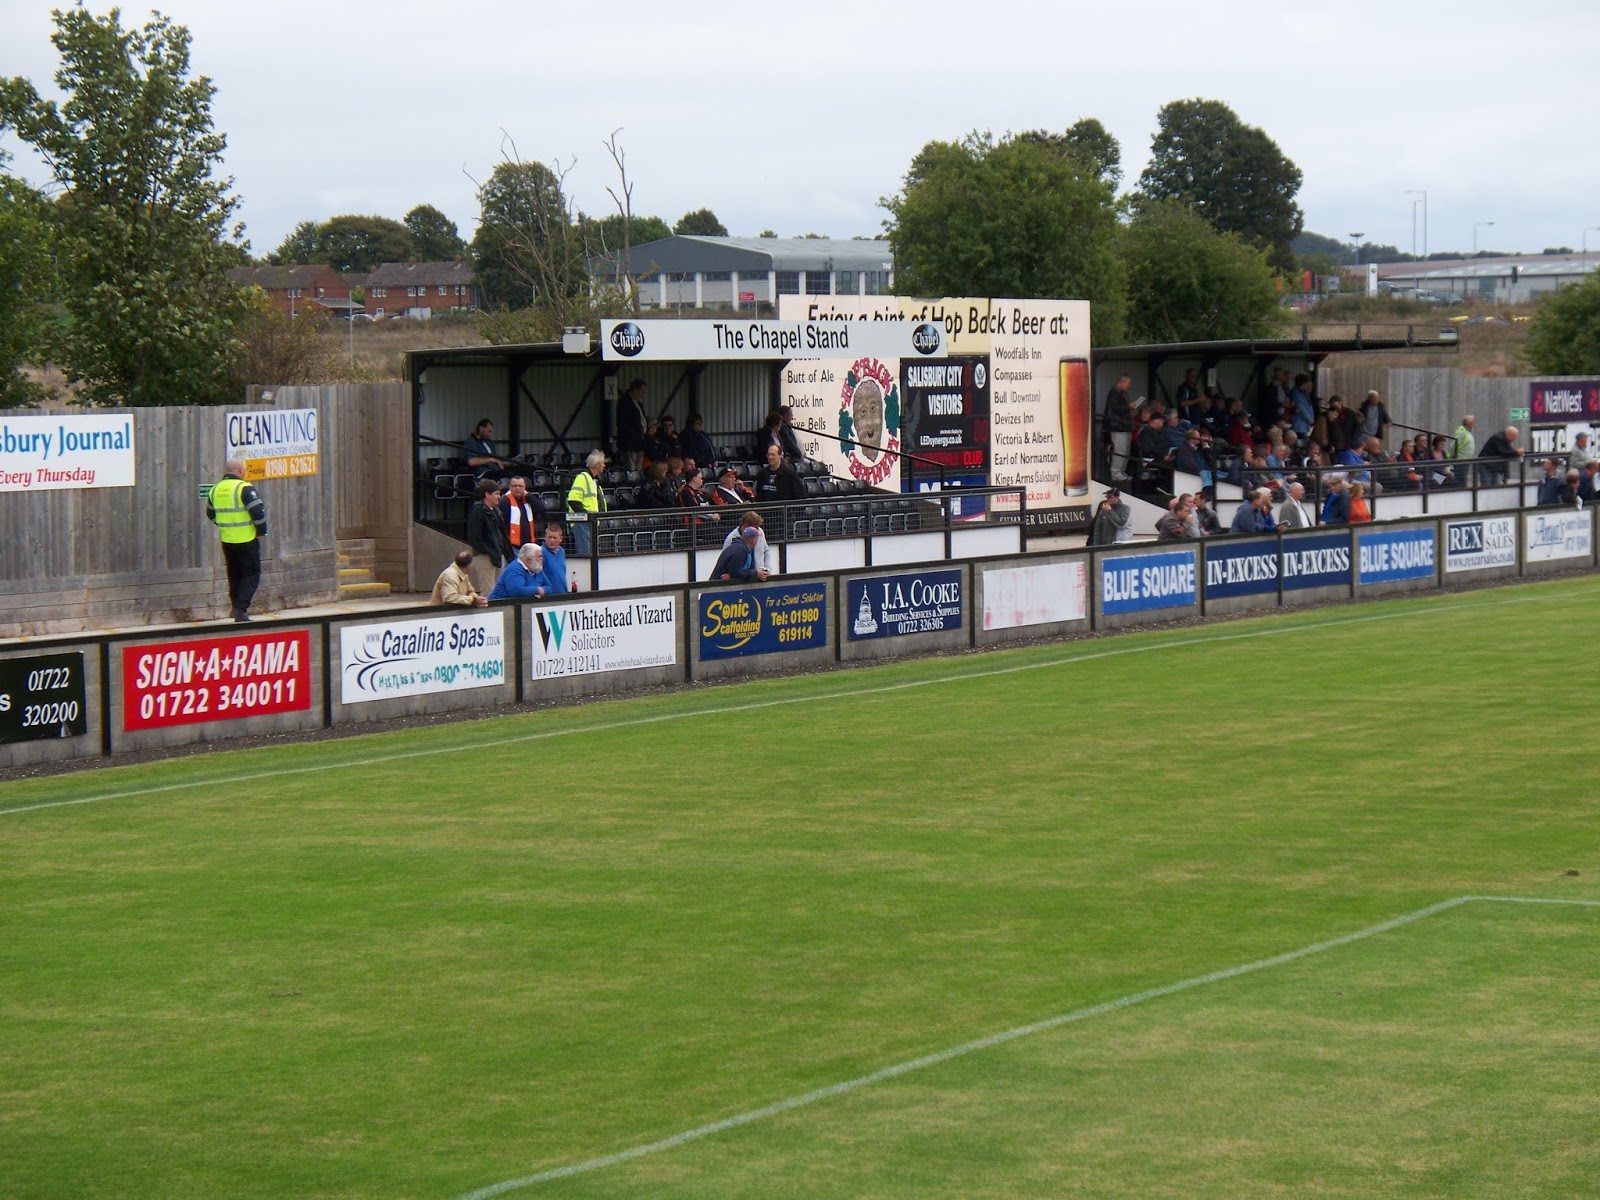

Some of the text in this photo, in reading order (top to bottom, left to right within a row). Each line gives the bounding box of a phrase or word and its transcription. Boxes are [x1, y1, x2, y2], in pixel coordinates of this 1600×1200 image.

[969, 307, 1006, 335] Back
[1013, 308, 1045, 335] Beer
[1050, 313, 1069, 335] at:
[611, 331, 644, 351] Chapel
[713, 324, 849, 354] The Chapel Stand
[913, 331, 940, 351] Chapel
[995, 347, 1042, 360] Woodfalls Inn
[787, 370, 834, 383] Butt of Ale
[908, 365, 963, 388] SALISBURY CITY
[994, 368, 1032, 384] Compasses
[788, 395, 824, 408] Duck Inn
[928, 393, 963, 416] VISITORS
[994, 390, 1041, 404] Bull (Downton)
[1545, 389, 1583, 414] NatWest
[808, 417, 826, 430] Bells
[994, 413, 1034, 425] Devizes Inn
[0, 422, 130, 460] bury Journal
[920, 434, 963, 447] LEDsynergy.co.uk
[994, 432, 1054, 445] Victoria & Albert
[265, 459, 288, 478] 01980
[289, 456, 316, 475] 621621
[963, 450, 983, 465] CLUB
[994, 452, 1058, 465] Earl of Normanton
[36, 467, 96, 484] Thursday
[995, 469, 1061, 486] Kings Arms (Salisbury)
[1038, 511, 1086, 524] LIGHTNING
[1489, 521, 1510, 535] CAR
[1449, 525, 1483, 551] REX
[1485, 535, 1514, 550] SALES
[1283, 547, 1350, 577] IN-EXCESS
[1360, 539, 1435, 573] BLUE SQUARE
[1207, 553, 1278, 586] IN-EXCESS
[1104, 563, 1195, 602] BLUE SQUARE
[766, 593, 824, 607] For a Sound Solution
[881, 579, 960, 611] J.A. COOKE
[569, 601, 673, 632] Whitehead Vizard
[703, 598, 750, 637] Sonic
[770, 607, 819, 626] Tel: 01980
[932, 610, 937, 618] &
[779, 626, 813, 643] 619114
[898, 617, 944, 635] 01722 326305
[381, 626, 445, 658] Catalina
[449, 622, 485, 656] Spas
[571, 633, 615, 652] Solicitors
[536, 658, 565, 677] 01722
[567, 654, 601, 674] 412141
[28, 667, 70, 692] 01722
[140, 678, 296, 720] 01722 340011
[22, 701, 78, 727] 320200
